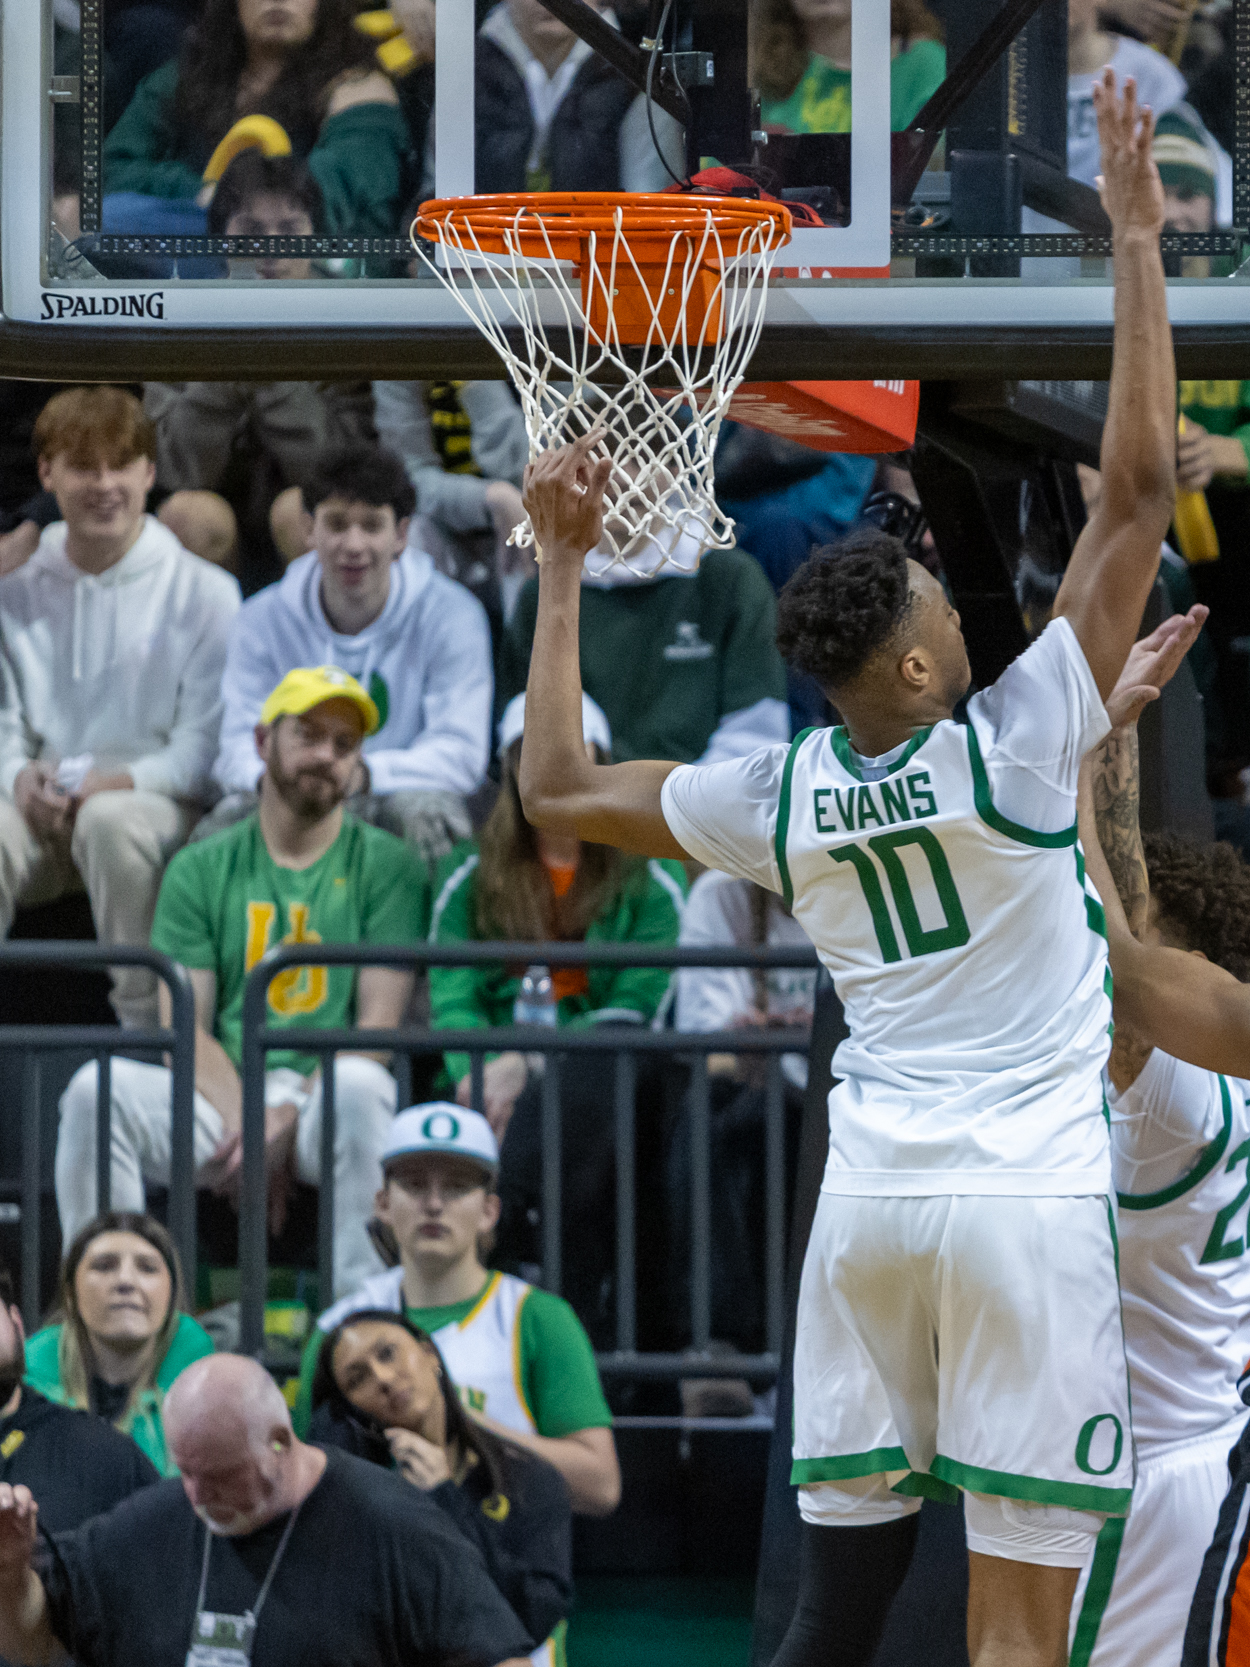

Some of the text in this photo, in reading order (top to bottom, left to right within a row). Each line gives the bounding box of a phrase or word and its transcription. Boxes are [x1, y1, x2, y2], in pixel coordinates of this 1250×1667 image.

[40, 291, 164, 320] SPALDING
[813, 770, 938, 833] EVANS
[826, 825, 971, 964] 10
[1074, 1412, 1124, 1476] O
